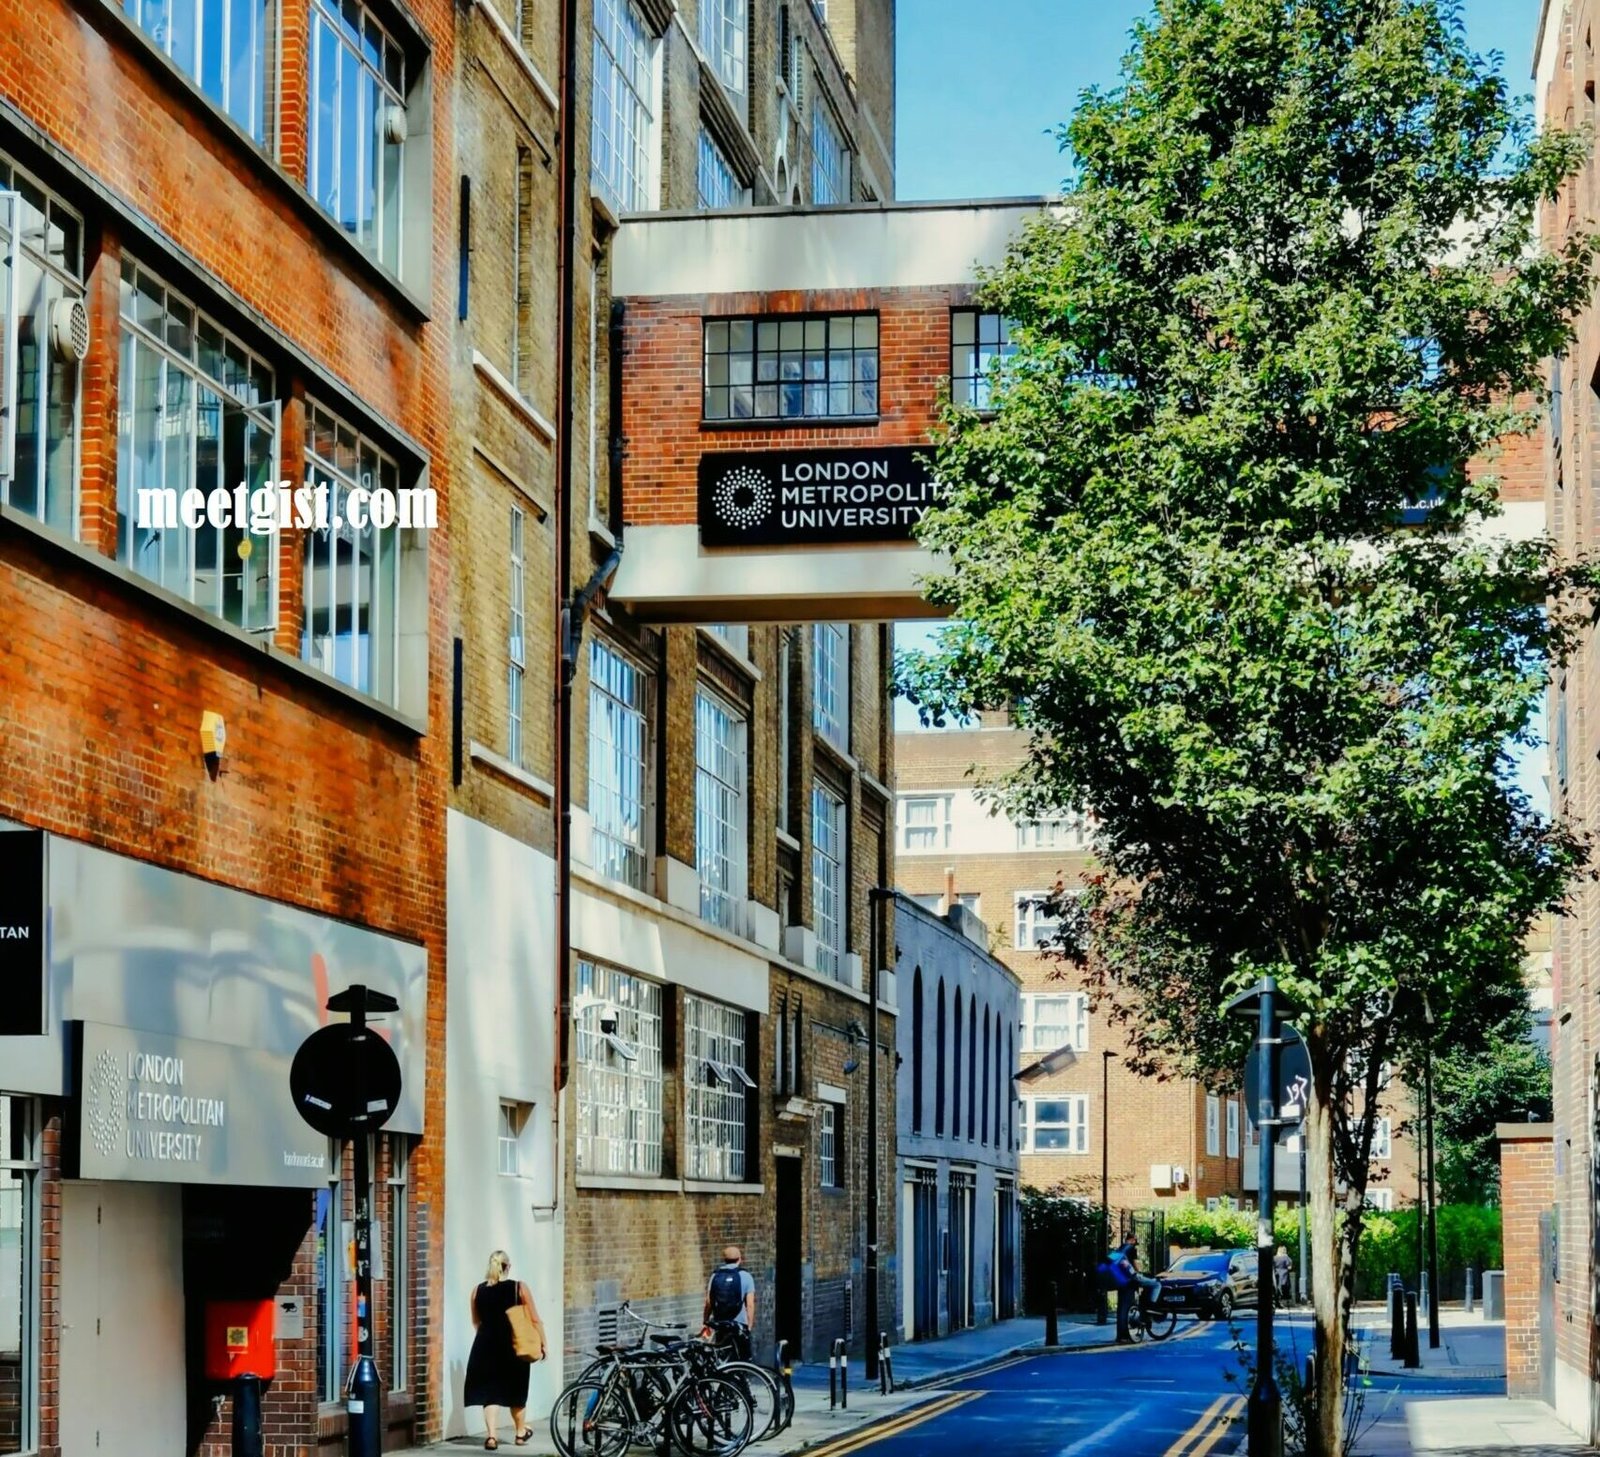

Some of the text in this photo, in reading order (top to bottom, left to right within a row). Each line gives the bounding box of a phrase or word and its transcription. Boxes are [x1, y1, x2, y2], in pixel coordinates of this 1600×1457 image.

[781, 461, 889, 482] LONDON
[781, 482, 954, 505] METROPOLITA
[781, 505, 931, 528] UNIVERSITY
[126, 1052, 184, 1086] LONDON
[126, 1090, 224, 1127] METROPOLITAN
[126, 1130, 202, 1162] UNIVERSITY
